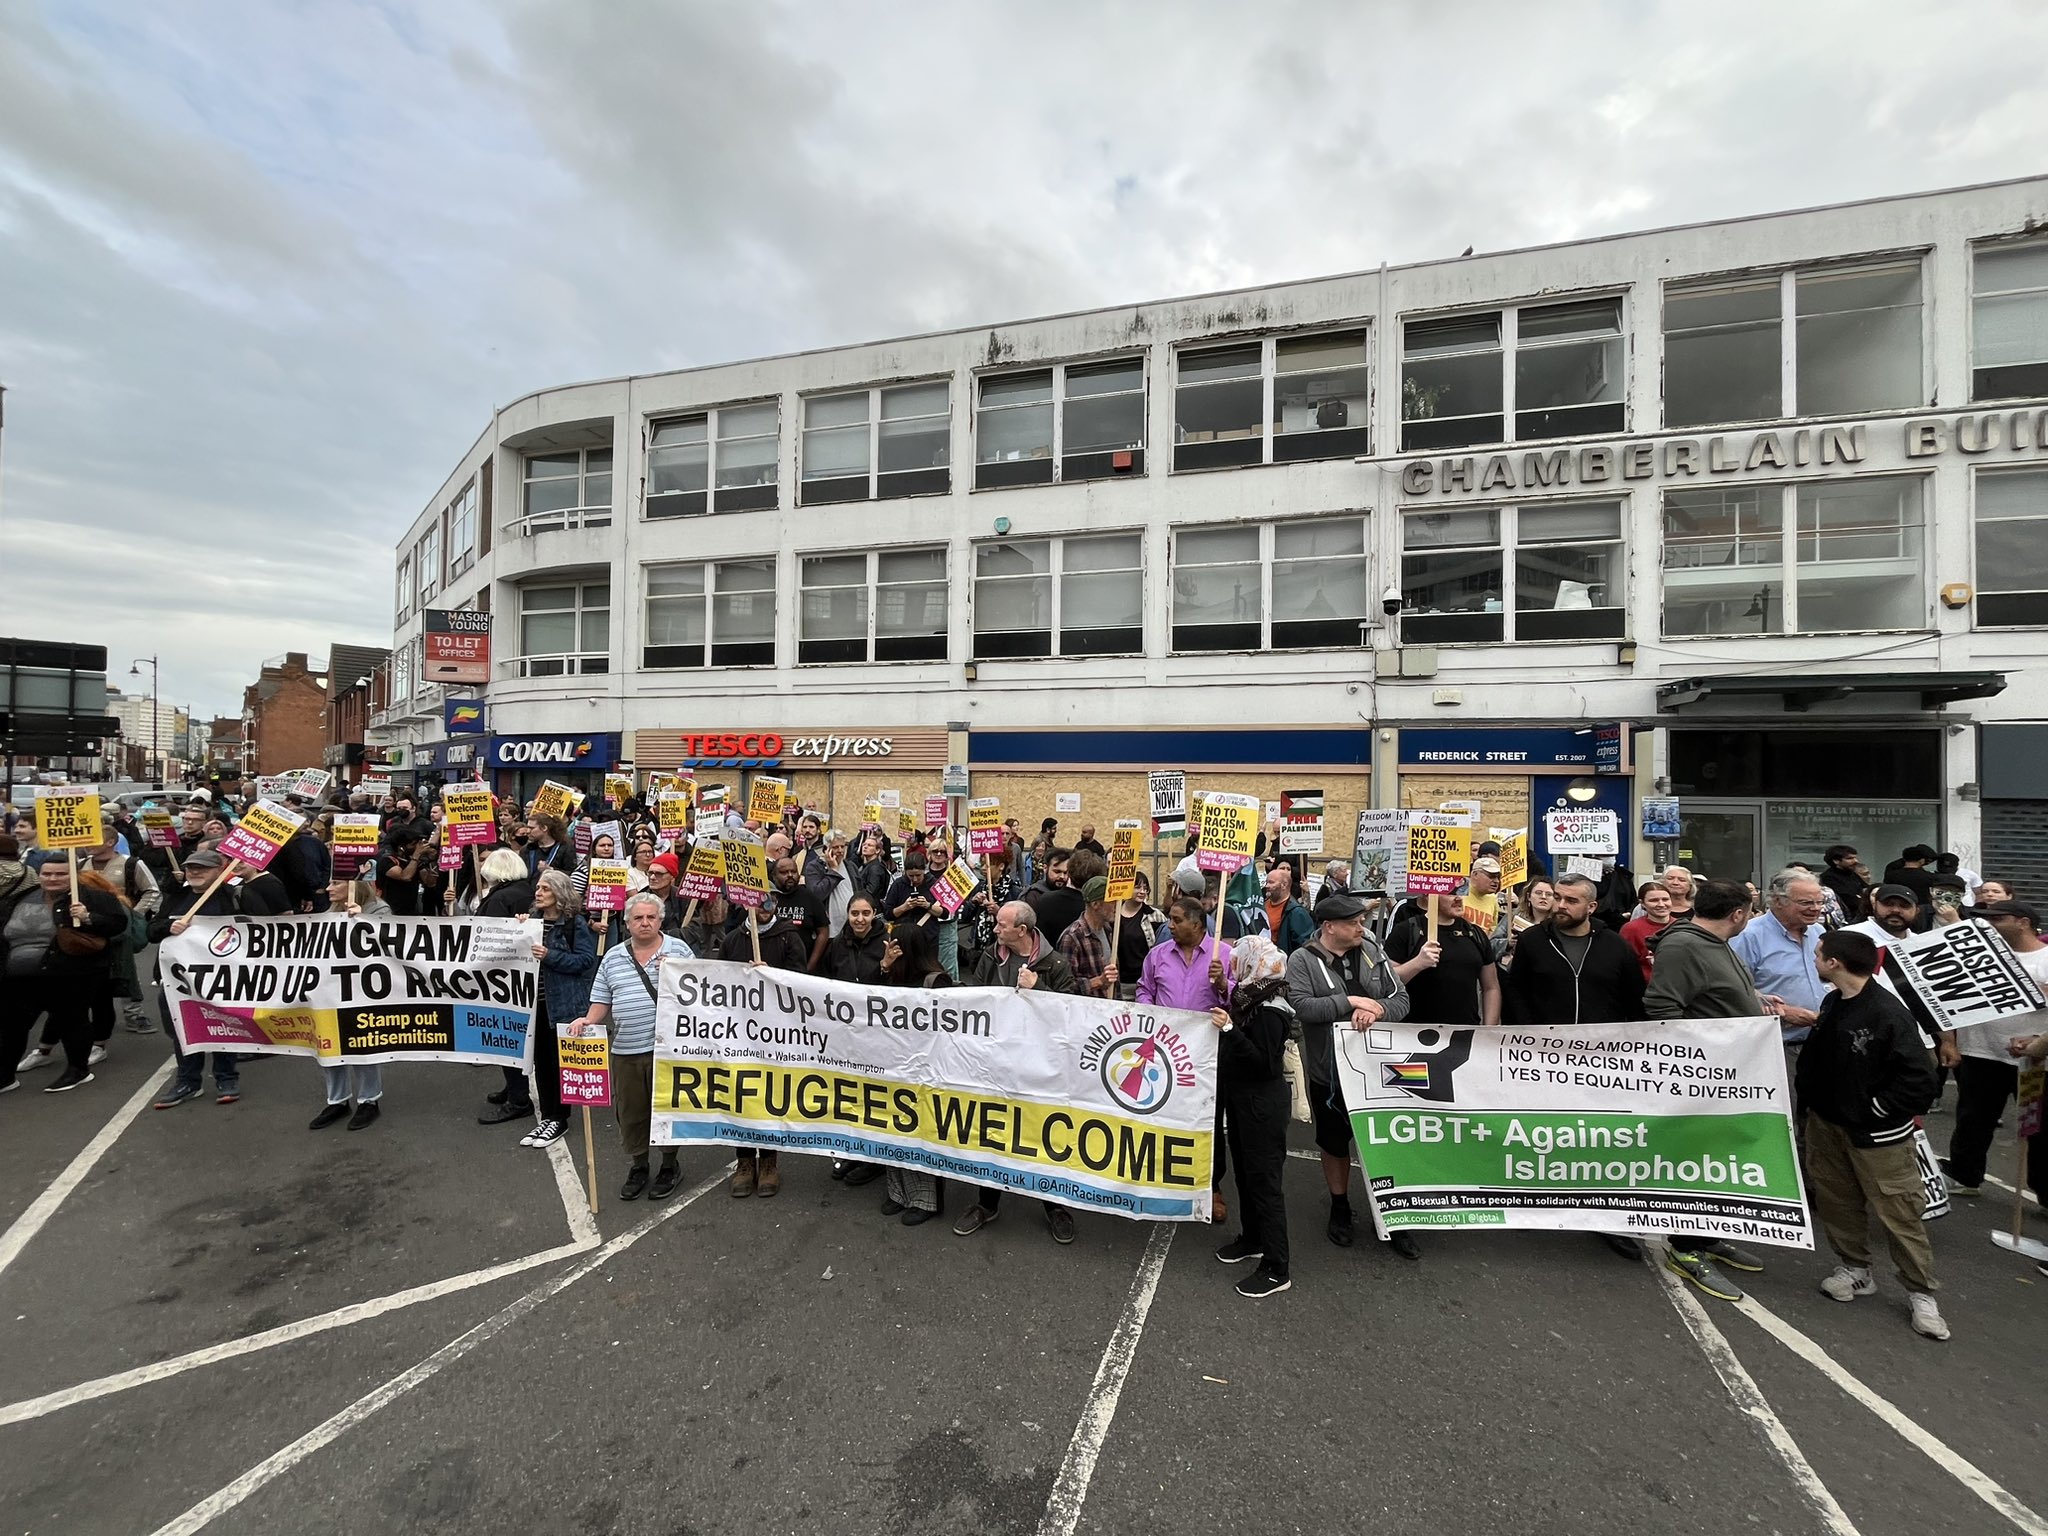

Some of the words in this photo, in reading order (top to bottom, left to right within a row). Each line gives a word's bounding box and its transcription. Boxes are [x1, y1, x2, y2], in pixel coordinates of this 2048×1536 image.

[1402, 425, 1866, 495] CHAMBERLAIN
[448, 612, 488, 622] MASON
[448, 620, 488, 631] YOUNG
[434, 636, 452, 647] TO
[456, 637, 481, 649] LET
[439, 649, 476, 658] OFFICES
[498, 741, 576, 762] CORAL
[681, 733, 783, 758] TESCO
[792, 734, 893, 763] express
[1419, 751, 1479, 761] FREDERICK
[1486, 751, 1528, 761] STREET
[754, 781, 776, 791] SMASH
[1150, 777, 1183, 792] CEASEFIRE
[45, 796, 84, 808] STOP
[447, 794, 488, 805] Refugees
[753, 791, 779, 802] FASCISM
[1155, 791, 1181, 810] NOW!
[45, 807, 76, 817] THE
[449, 804, 488, 813] welcome
[758, 801, 781, 812] RACISM
[1206, 805, 1221, 817] NO
[1224, 808, 1237, 818] TO
[1769, 806, 1863, 815] CHAMBERLAIN
[1869, 807, 1933, 816] BUILDING
[460, 813, 480, 821] here
[970, 809, 999, 818] Refugees
[1287, 813, 1317, 825] FREE
[1553, 815, 1610, 823] APARTHEID
[46, 817, 75, 828] FAR
[250, 808, 294, 834] Refugees
[971, 818, 998, 827] welcome
[47, 825, 93, 838] RIGHT
[243, 818, 285, 842] welcome
[335, 827, 353, 835] Stamp
[971, 830, 985, 840] Stop
[986, 829, 998, 838] the
[1203, 826, 1219, 837] NO
[1222, 828, 1236, 839] TO
[1281, 825, 1322, 833] PALESTINE
[1411, 828, 1428, 839] NO
[1431, 829, 1447, 839] TO
[1569, 823, 1598, 833] OFF
[233, 827, 257, 848] Stop
[254, 838, 273, 853] the
[335, 834, 375, 843] Islamophobia
[1202, 837, 1248, 852] FASCISM
[1553, 833, 1610, 843] CAMPUS
[224, 837, 246, 852] far
[240, 844, 266, 862] right
[694, 848, 719, 860] Oppose
[1112, 848, 1135, 862] FASCISM
[1410, 850, 1428, 860] NO
[1431, 850, 1447, 861] TO
[692, 856, 716, 868] Tommy
[1200, 850, 1217, 859] Unite
[1218, 853, 1240, 863] against
[689, 863, 719, 875] Robinson
[1211, 859, 1221, 867] far
[1221, 860, 1236, 869] right
[1410, 860, 1461, 873] FASCISM
[592, 868, 626, 878] Refugees
[1409, 874, 1427, 883] Unite
[1428, 876, 1454, 885] against
[590, 885, 612, 893] Black
[1409, 882, 1420, 890] the
[1421, 882, 1432, 890] far
[1433, 883, 1449, 892] right
[589, 892, 609, 901] Lives
[588, 900, 615, 909] Matter
[777, 907, 805, 915] YEARS
[246, 921, 472, 962] BIRMINGHAM
[1944, 924, 2029, 1015] CEASEFIRE
[1909, 941, 1991, 1016] NOW!
[170, 963, 278, 1001] STAND
[282, 965, 320, 1003] UP
[331, 963, 392, 1002] TO
[402, 964, 535, 1008] RACISM
[1899, 953, 1922, 984] PALESTINE
[1918, 986, 1931, 999] END
[1928, 997, 1953, 1028] APARTHEID
[676, 973, 765, 1012] Stand
[775, 984, 816, 1023] Up
[823, 993, 855, 1024] to
[866, 995, 991, 1037] Racism
[356, 1012, 411, 1029] Stamp
[415, 1011, 439, 1025] out
[466, 1011, 499, 1029] Black
[502, 1015, 528, 1034] Lives
[348, 1029, 448, 1048] antisemitism
[675, 1014, 739, 1040] Black
[746, 1018, 829, 1053] Country
[481, 1031, 519, 1050] Matter
[561, 1040, 605, 1055] Refugees
[1079, 1024, 1112, 1071] STAND
[1110, 1013, 1132, 1035] UP
[1137, 1014, 1155, 1034] TO
[1155, 1023, 1196, 1087] RACISM
[1510, 1034, 1536, 1046] NO
[1541, 1037, 1564, 1049] TO
[1568, 1039, 1706, 1061] ISLAMOPHOBIA
[561, 1054, 603, 1065] welcome
[681, 1045, 714, 1057] Dudley
[724, 1047, 765, 1059] Sandwell
[775, 1051, 807, 1062] Walsall
[817, 1055, 885, 1075] Wolverhampton
[1508, 1049, 1533, 1062] NO
[1537, 1051, 1561, 1065] TO
[1565, 1053, 1634, 1072] RACISM
[1640, 1060, 1653, 1073] &
[1658, 1062, 1737, 1080] FASCISM
[562, 1069, 582, 1084] Stop
[584, 1072, 603, 1083] the
[1508, 1066, 1541, 1082] YES
[1546, 1070, 1569, 1084] TO
[1574, 1072, 1665, 1094] EQUALITY
[1669, 1082, 1683, 1096] &
[1688, 1084, 1777, 1100] DIVERSITY
[563, 1083, 577, 1095] far
[579, 1085, 604, 1099] right
[671, 1066, 919, 1133] REFUGEES
[932, 1093, 1195, 1186] WELCOME
[1367, 1115, 1492, 1145] LGBT+
[1502, 1118, 1648, 1154] Against
[720, 1127, 865, 1152] www.standuptoracism.org.uk
[875, 1145, 1026, 1186] info@standuptoracism.org.uk
[1038, 1178, 1136, 1211] @AntiRacismDay
[1505, 1154, 1768, 1187] Islamophobia
[1390, 1197, 1409, 1208] Gay,
[1411, 1195, 1449, 1206] Bisexual
[1451, 1195, 1459, 1205] &
[1460, 1196, 1486, 1205] Trans
[1488, 1196, 1521, 1207] people
[1524, 1197, 1533, 1205] in
[1536, 1196, 1582, 1208] solidarity
[1582, 1197, 1606, 1206] with
[1608, 1197, 1647, 1209] Muslim
[1650, 1199, 1720, 1213] communities
[1722, 1204, 1758, 1217] under
[1760, 1209, 1800, 1223] attack
[1627, 1214, 1803, 1242] #MuslimLivesMatter
